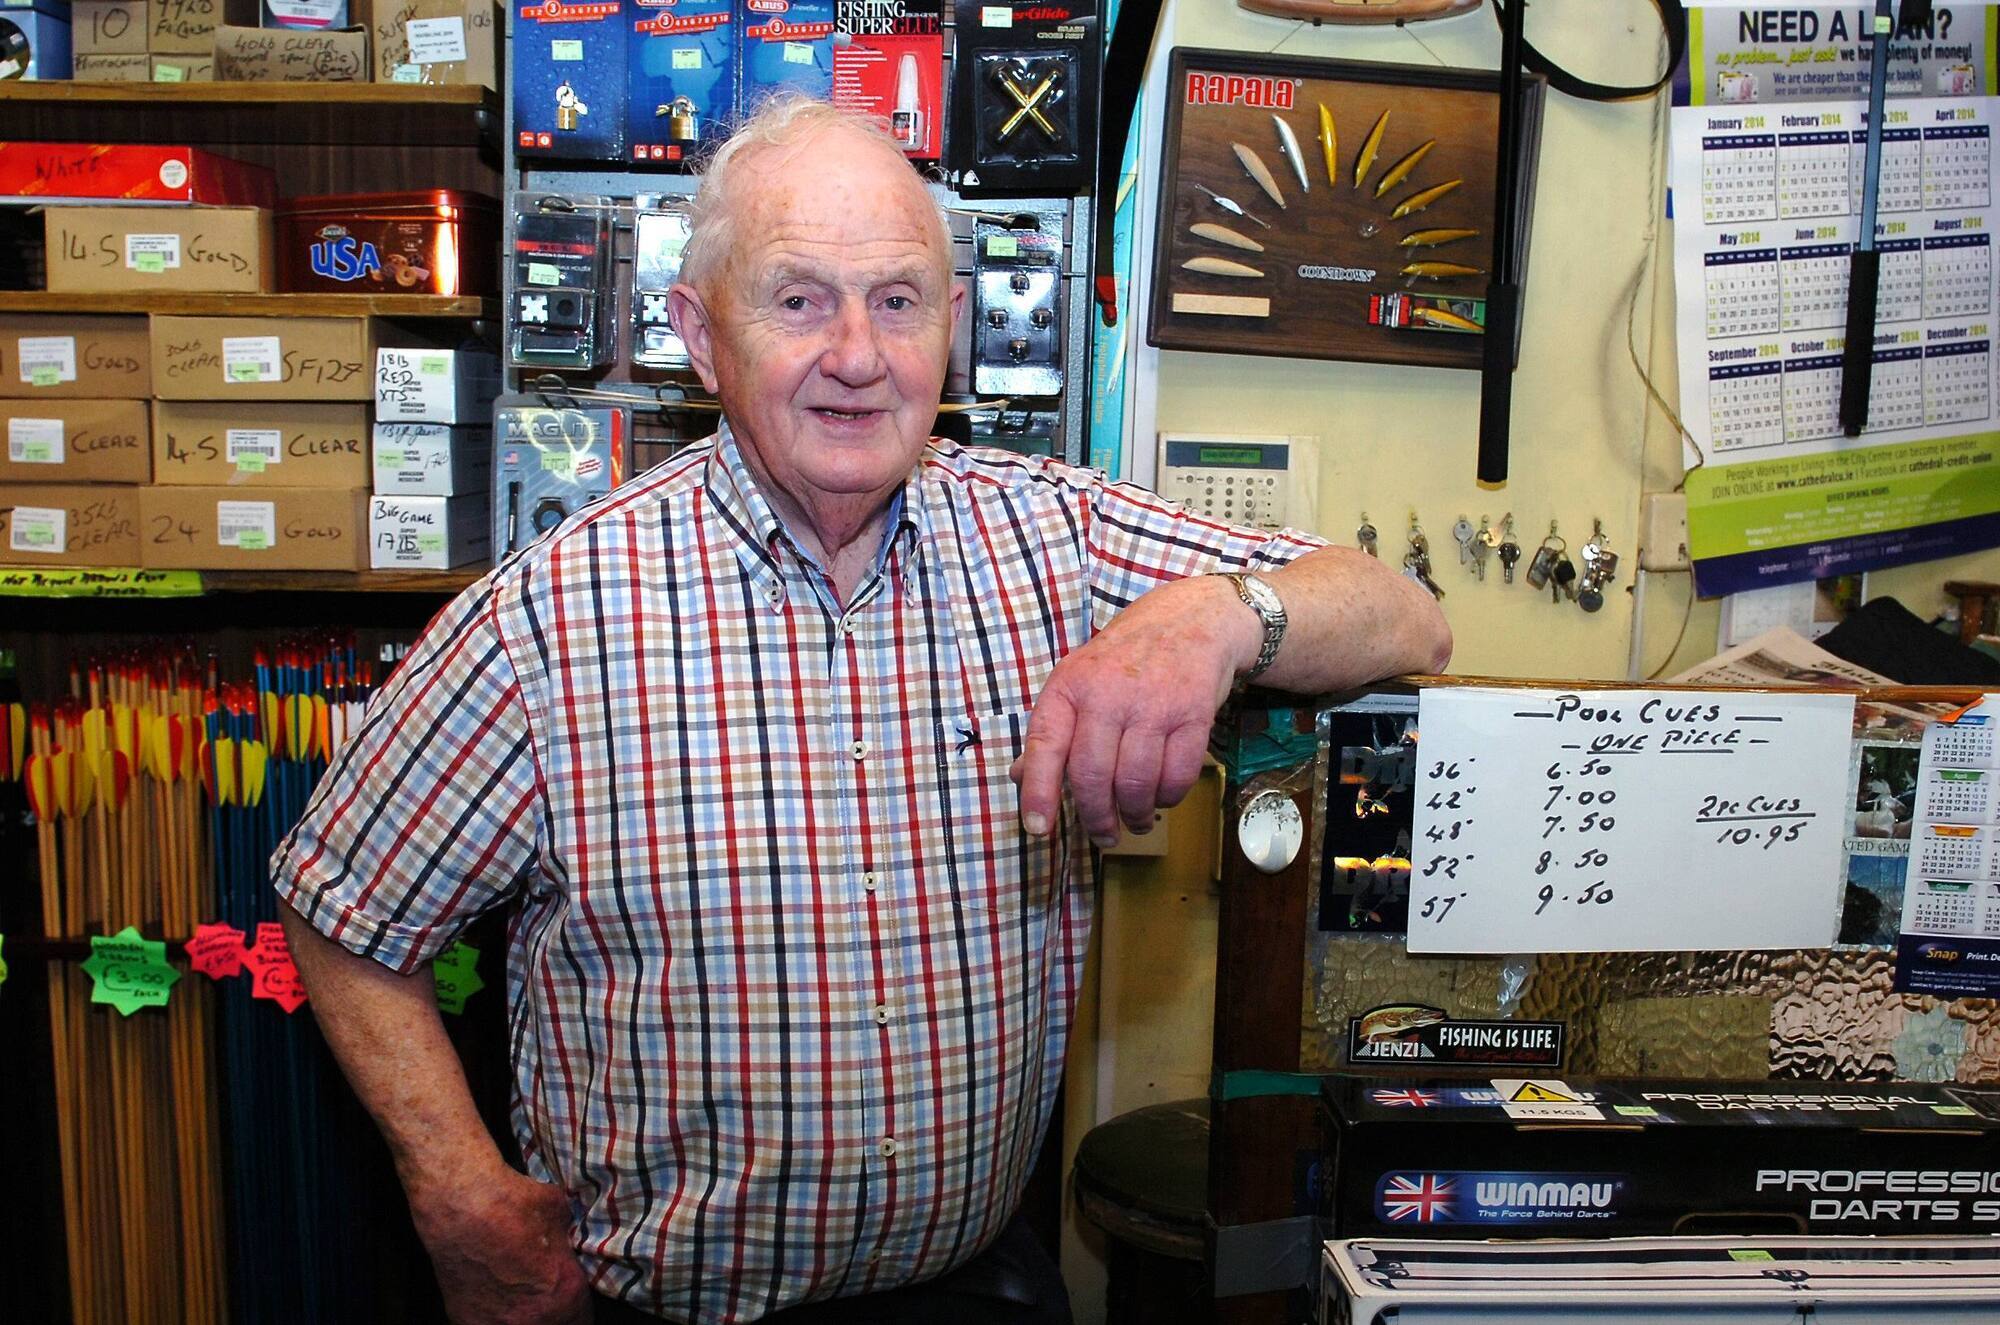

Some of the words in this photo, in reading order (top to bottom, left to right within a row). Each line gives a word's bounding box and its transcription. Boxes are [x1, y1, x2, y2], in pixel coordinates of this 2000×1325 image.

[838, 1, 906, 17] FISHING
[93, 8, 130, 45] 10
[1739, 10, 1818, 43] NEED
[1829, 10, 1848, 42] A
[1841, 49, 1855, 62] we
[1921, 44, 1932, 59] of
[1935, 43, 1972, 63] money!
[1773, 72, 1785, 84] We
[1786, 74, 1800, 84] are
[1803, 72, 1834, 86] cheaper
[1837, 71, 1855, 83] than
[1707, 118, 1742, 130] January
[1744, 116, 1765, 129] 2014
[1781, 115, 1819, 127] February
[1821, 113, 1841, 126] 2014
[1889, 111, 1909, 123] 2014
[1936, 109, 1955, 121] April
[1956, 108, 1975, 120] 2014
[1887, 222, 1906, 234] 2014
[1934, 219, 1962, 231] August
[1963, 217, 1982, 229] 2014
[1719, 233, 1738, 246] May
[1740, 231, 1760, 244] 2014
[1795, 228, 1814, 240] June
[1816, 226, 1837, 239] 2014
[310, 237, 381, 281] USA
[1299, 265, 1371, 282] COUNTDOWN
[1900, 331, 1920, 343] 2014
[1927, 327, 1967, 340] December
[1969, 325, 1987, 337] 2014
[1708, 347, 1757, 361] September
[1759, 344, 1780, 356] 2014
[1791, 341, 1824, 354] October
[1826, 338, 1846, 351] 2014
[379, 367, 413, 387] RED
[71, 431, 140, 454] CLEAR
[288, 434, 361, 457] CLEAR
[1757, 464, 1789, 478] Working
[1711, 486, 1731, 499] JOIN
[1733, 482, 1764, 497] ONLINE
[400, 511, 434, 525] GAME
[153, 515, 200, 544] 24
[284, 518, 341, 539] GOLD
[1591, 734, 1649, 751] ONE
[1547, 758, 1612, 779] 6.50
[1543, 785, 1616, 811] 7.00
[1542, 812, 1615, 839] 7.50
[1717, 821, 1807, 850] 10.95
[1535, 849, 1608, 875] 8.50
[1535, 880, 1614, 915] 9.50
[1926, 948, 1959, 961] Snap
[1966, 952, 1990, 961] Print.
[1439, 1027, 1501, 1048] FISHING
[1505, 1029, 1518, 1048] IS
[1522, 1029, 1556, 1049] LIFE.
[1371, 1042, 1419, 1058] JENZI
[1641, 1093, 1938, 1104] PROFESSIONAL
[1829, 1103, 1899, 1111] SET
[1476, 1182, 1613, 1207] WINMAU
[1478, 1209, 1497, 1217] The
[1501, 1209, 1533, 1217] Force
[1536, 1209, 1573, 1218] Behind
[1809, 1200, 1961, 1221] DARTS
